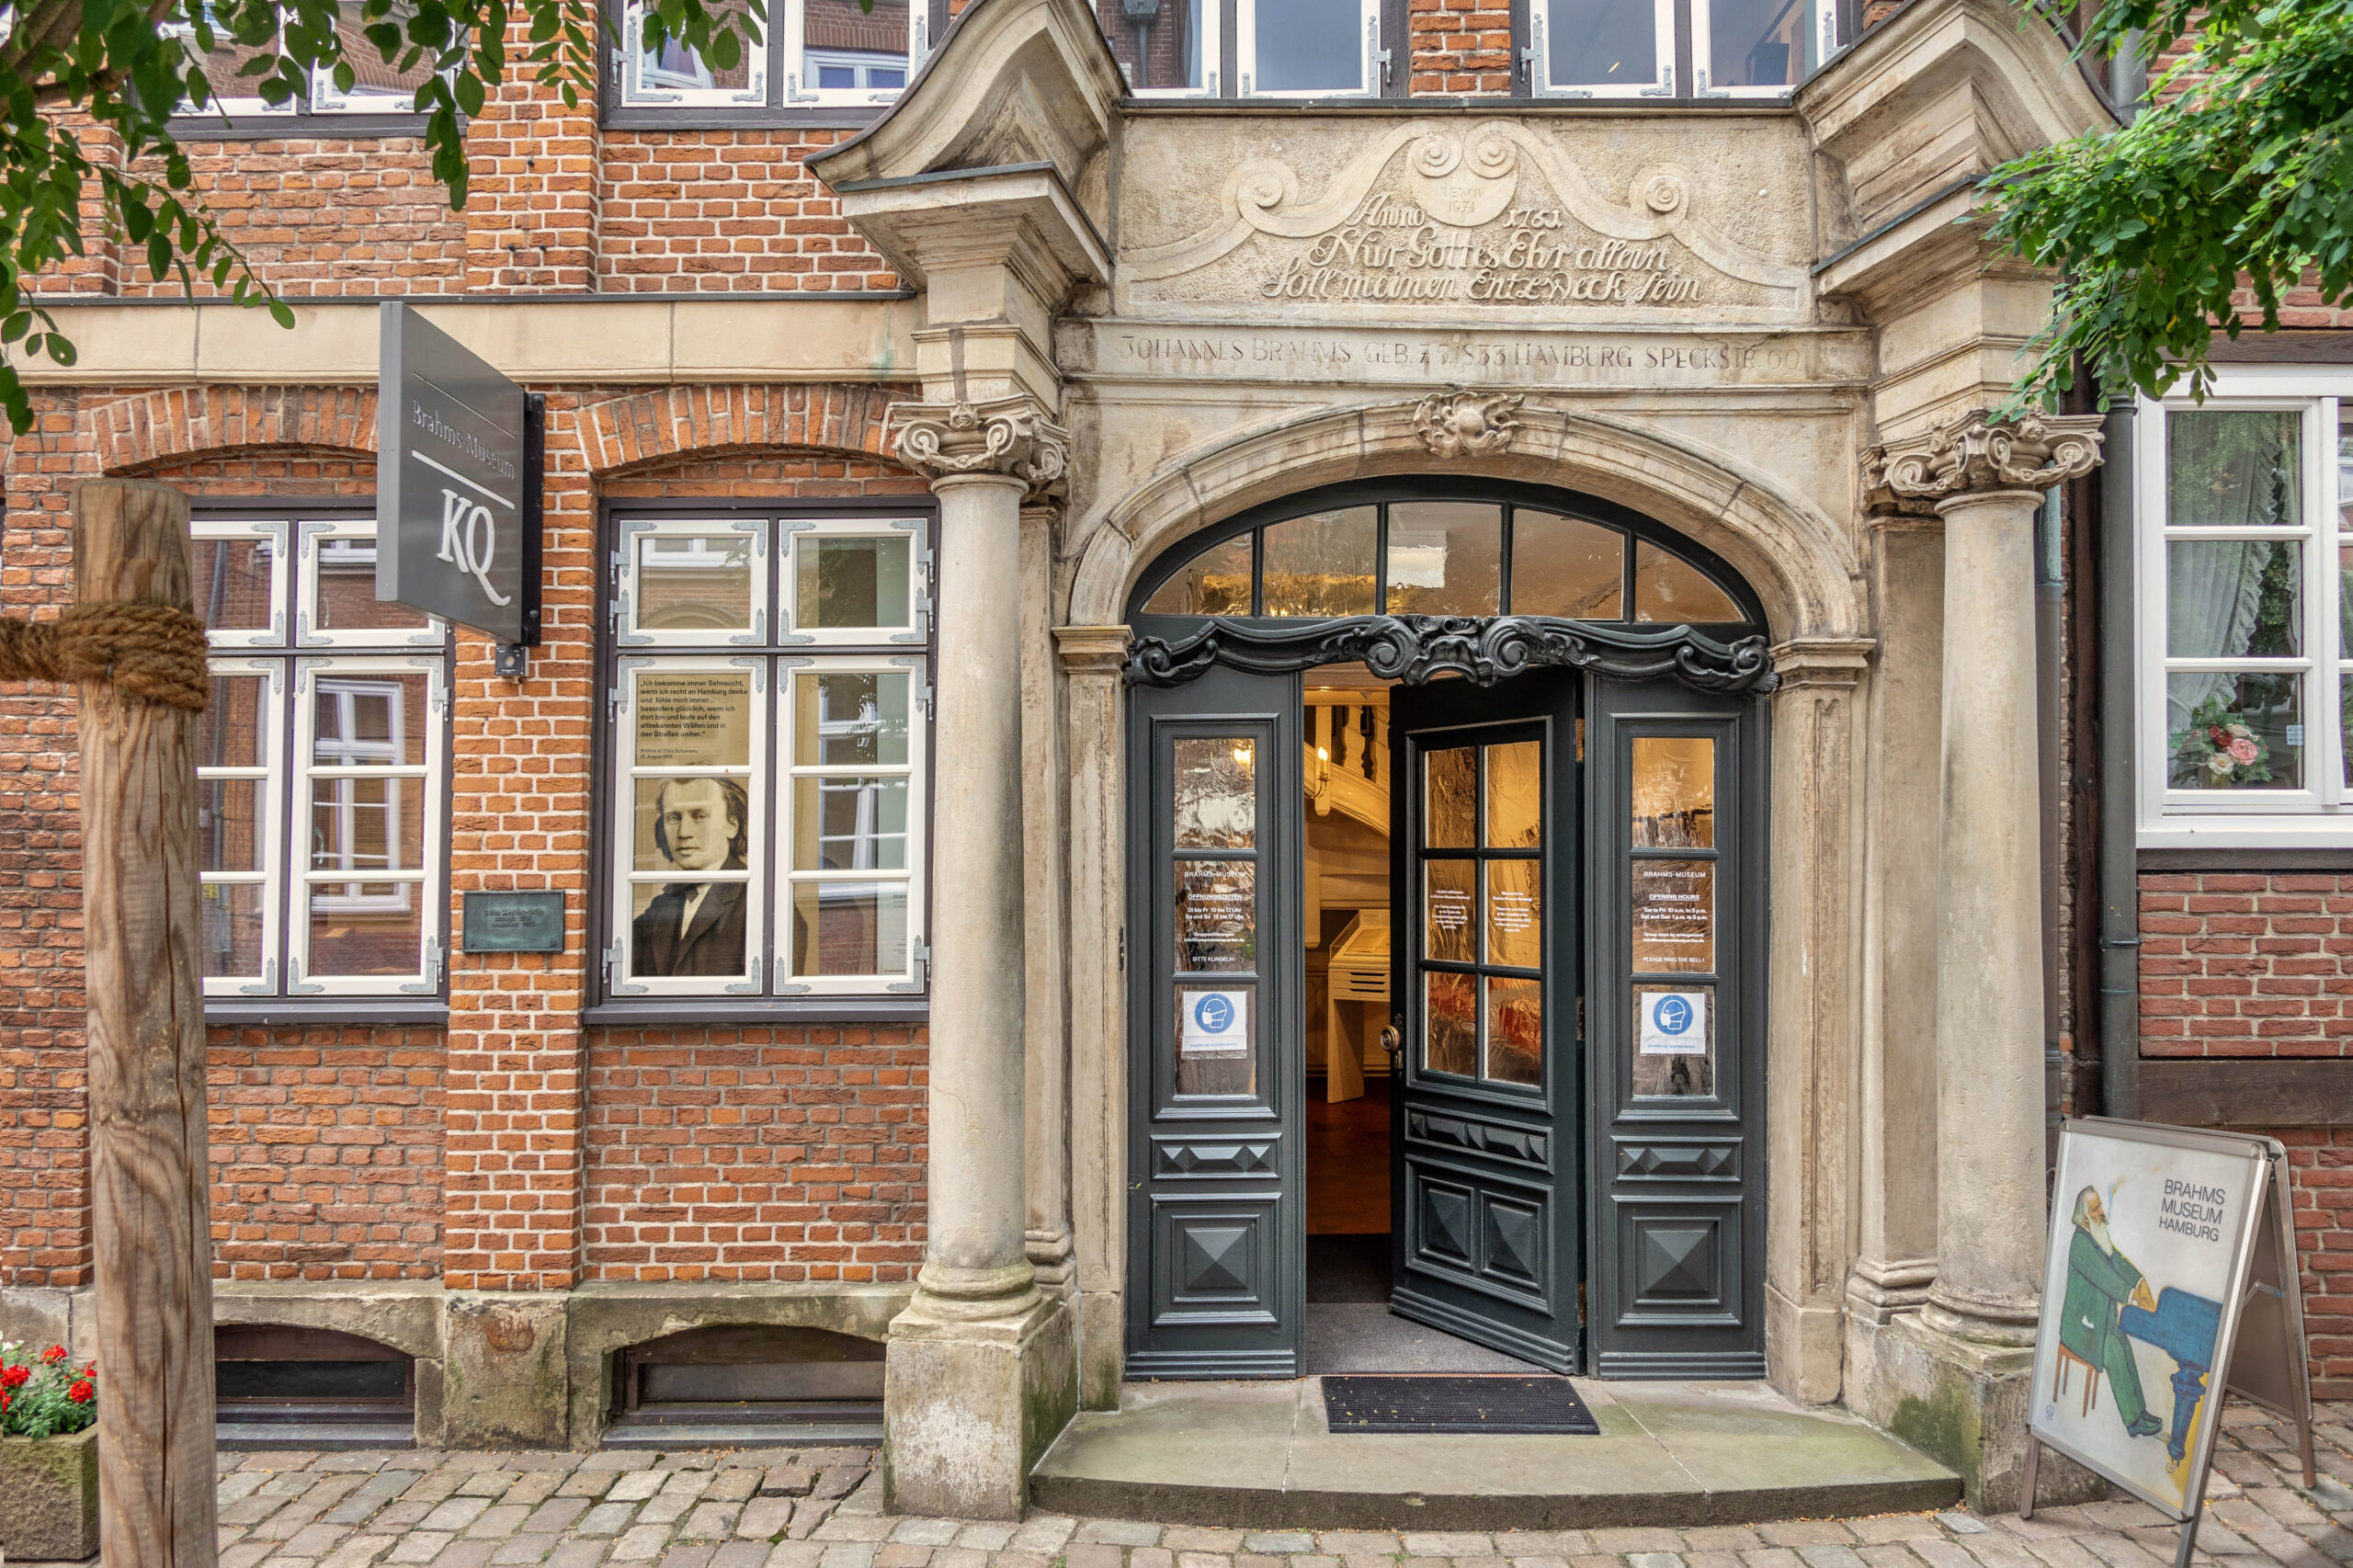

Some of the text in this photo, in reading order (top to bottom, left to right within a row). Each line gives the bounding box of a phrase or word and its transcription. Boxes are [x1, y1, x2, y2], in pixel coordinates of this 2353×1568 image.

[1345, 192, 1426, 228] Anno
[1449, 200, 1475, 213] 1971
[1309, 227, 1672, 270] Nur Gottes Ehr allein
[1341, 273, 1460, 300] meinen
[1119, 335, 1244, 360] JOHANNES
[1252, 337, 1351, 362] BRAHMS
[1364, 344, 1413, 364] GEB.
[1514, 344, 1632, 368] HAMBURG
[1767, 348, 1801, 369] 60
[413, 400, 515, 479] Brahms-Museum
[436, 489, 511, 607] KQ
[2164, 1178, 2226, 1205] BRAHMS
[2161, 1197, 2222, 1224] MUSEUM
[2158, 1215, 2219, 1242] HAMBURG
